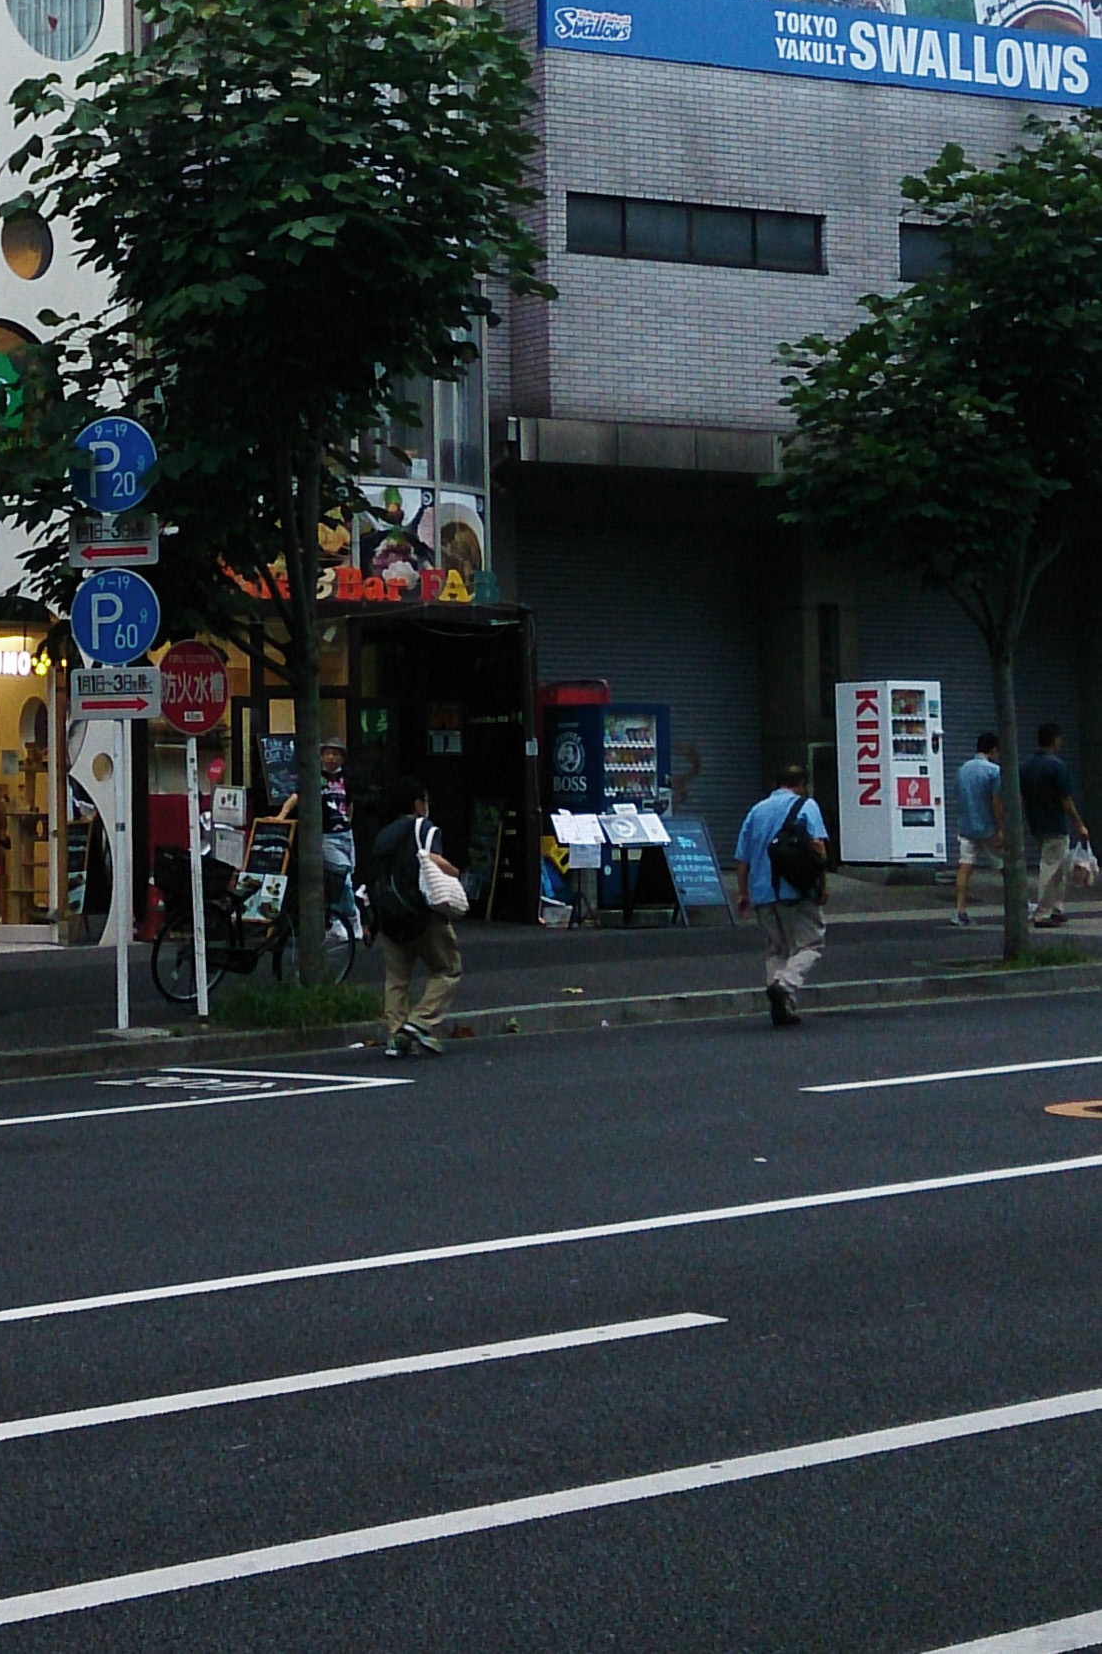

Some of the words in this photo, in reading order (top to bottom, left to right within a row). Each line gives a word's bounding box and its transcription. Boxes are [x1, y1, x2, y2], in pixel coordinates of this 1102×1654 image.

[556, 8, 630, 40] Swallows
[775, 11, 838, 38] TOKYO
[775, 37, 846, 66] YAKULT
[849, 21, 1089, 94] SWALLOWS
[89, 441, 121, 498] P
[112, 471, 136, 497] 20
[97, 576, 130, 590] 9-19
[335, 566, 406, 602] Bar
[91, 593, 124, 650] P
[114, 623, 138, 648] 60
[855, 690, 882, 806] KIRIN
[552, 775, 587, 792] BOSS
